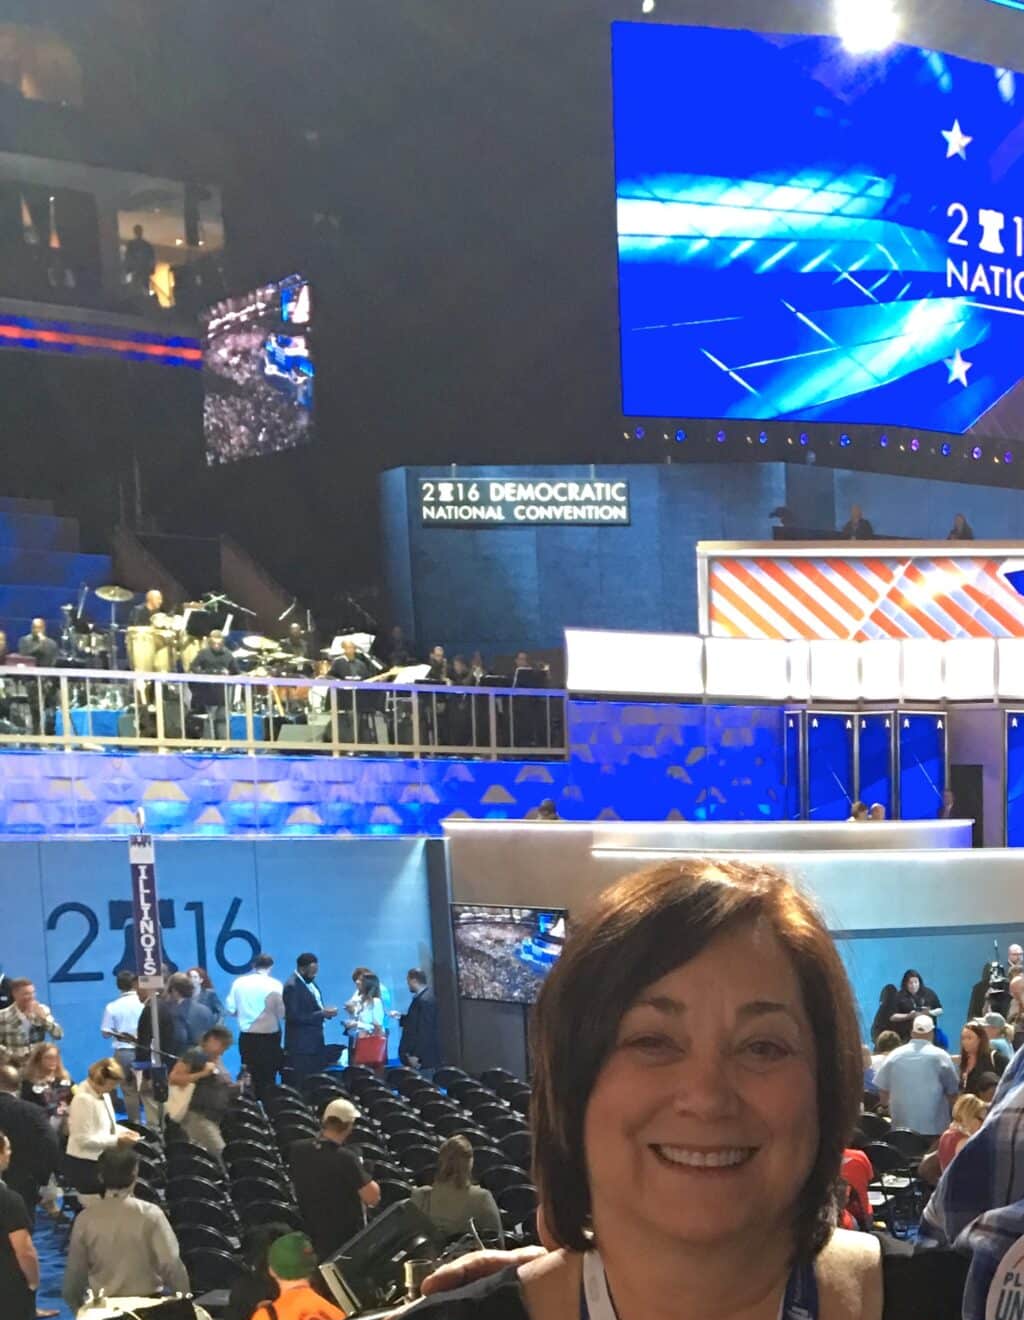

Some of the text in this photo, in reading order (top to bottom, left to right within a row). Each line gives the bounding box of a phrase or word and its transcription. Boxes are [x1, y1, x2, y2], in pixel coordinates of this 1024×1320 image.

[489, 482, 627, 502] DEMOCRATIC
[422, 505, 627, 520] NATIONAL CONVENTION
[138, 865, 157, 976] ILLINOIS
